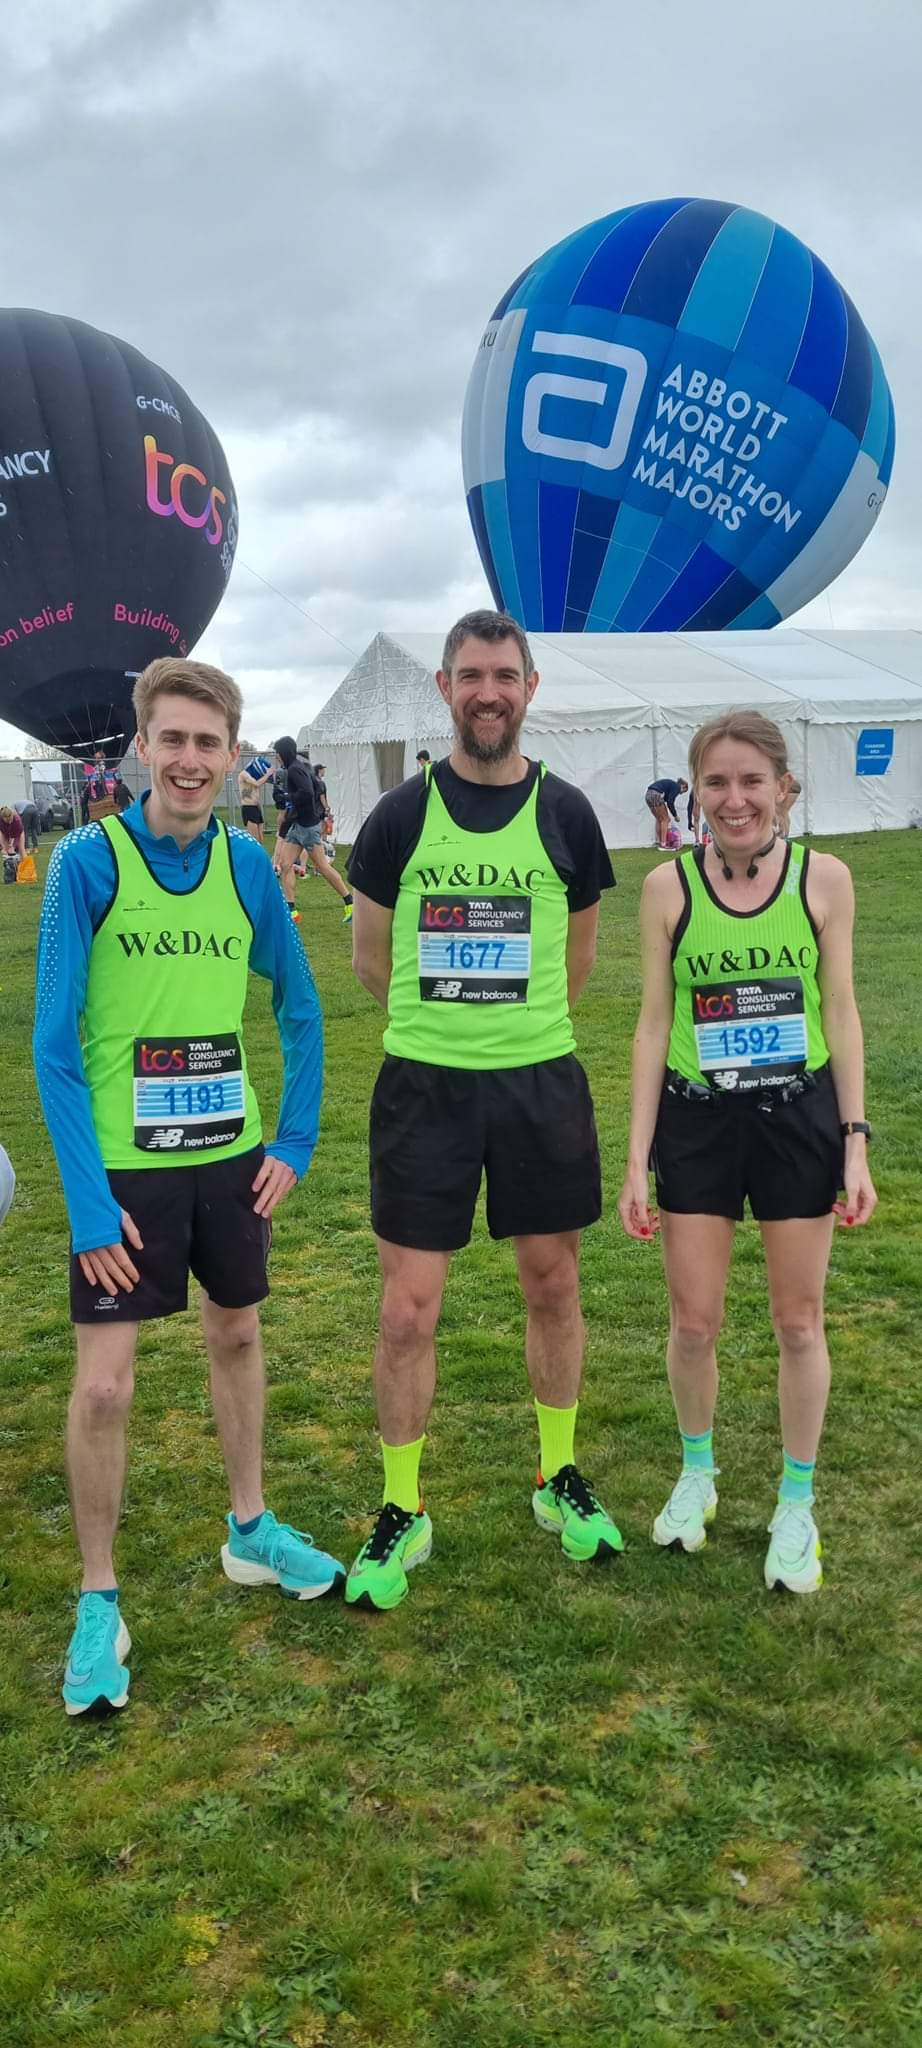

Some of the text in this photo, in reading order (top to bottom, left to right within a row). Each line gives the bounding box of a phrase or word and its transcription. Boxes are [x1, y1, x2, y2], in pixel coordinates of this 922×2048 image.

[662, 363, 788, 440] ABBOTT
[654, 391, 761, 461] WORLD
[144, 434, 226, 545] tcs
[642, 423, 802, 533] MARATHON
[632, 455, 747, 531] MAJORS
[19, 602, 75, 635] belief
[114, 603, 181, 644] Building
[415, 863, 545, 893] W&DAC
[425, 901, 465, 928] tcs
[468, 902, 493, 910] TATA
[468, 910, 524, 919] CONSULTANCY
[468, 920, 505, 928] SERVICES
[116, 930, 242, 960] W&DAC
[445, 942, 506, 969] 1677
[686, 945, 811, 978] W&DAC
[462, 991, 481, 999] new
[482, 990, 518, 1000] balance
[736, 986, 762, 995] TATA
[736, 991, 796, 1005] CONSULTANCY
[696, 993, 735, 1019] tcs
[737, 1003, 777, 1014] SERVICES
[188, 1042, 213, 1051] TATA
[188, 1047, 236, 1060] CONSULTANCY
[719, 1025, 781, 1057] 1592
[140, 1044, 184, 1072] tcs
[188, 1060, 222, 1070] SERVICES
[739, 1079, 758, 1088] new
[164, 1083, 225, 1116] 1193
[184, 1138, 204, 1147] new
[204, 1132, 236, 1145] balance
